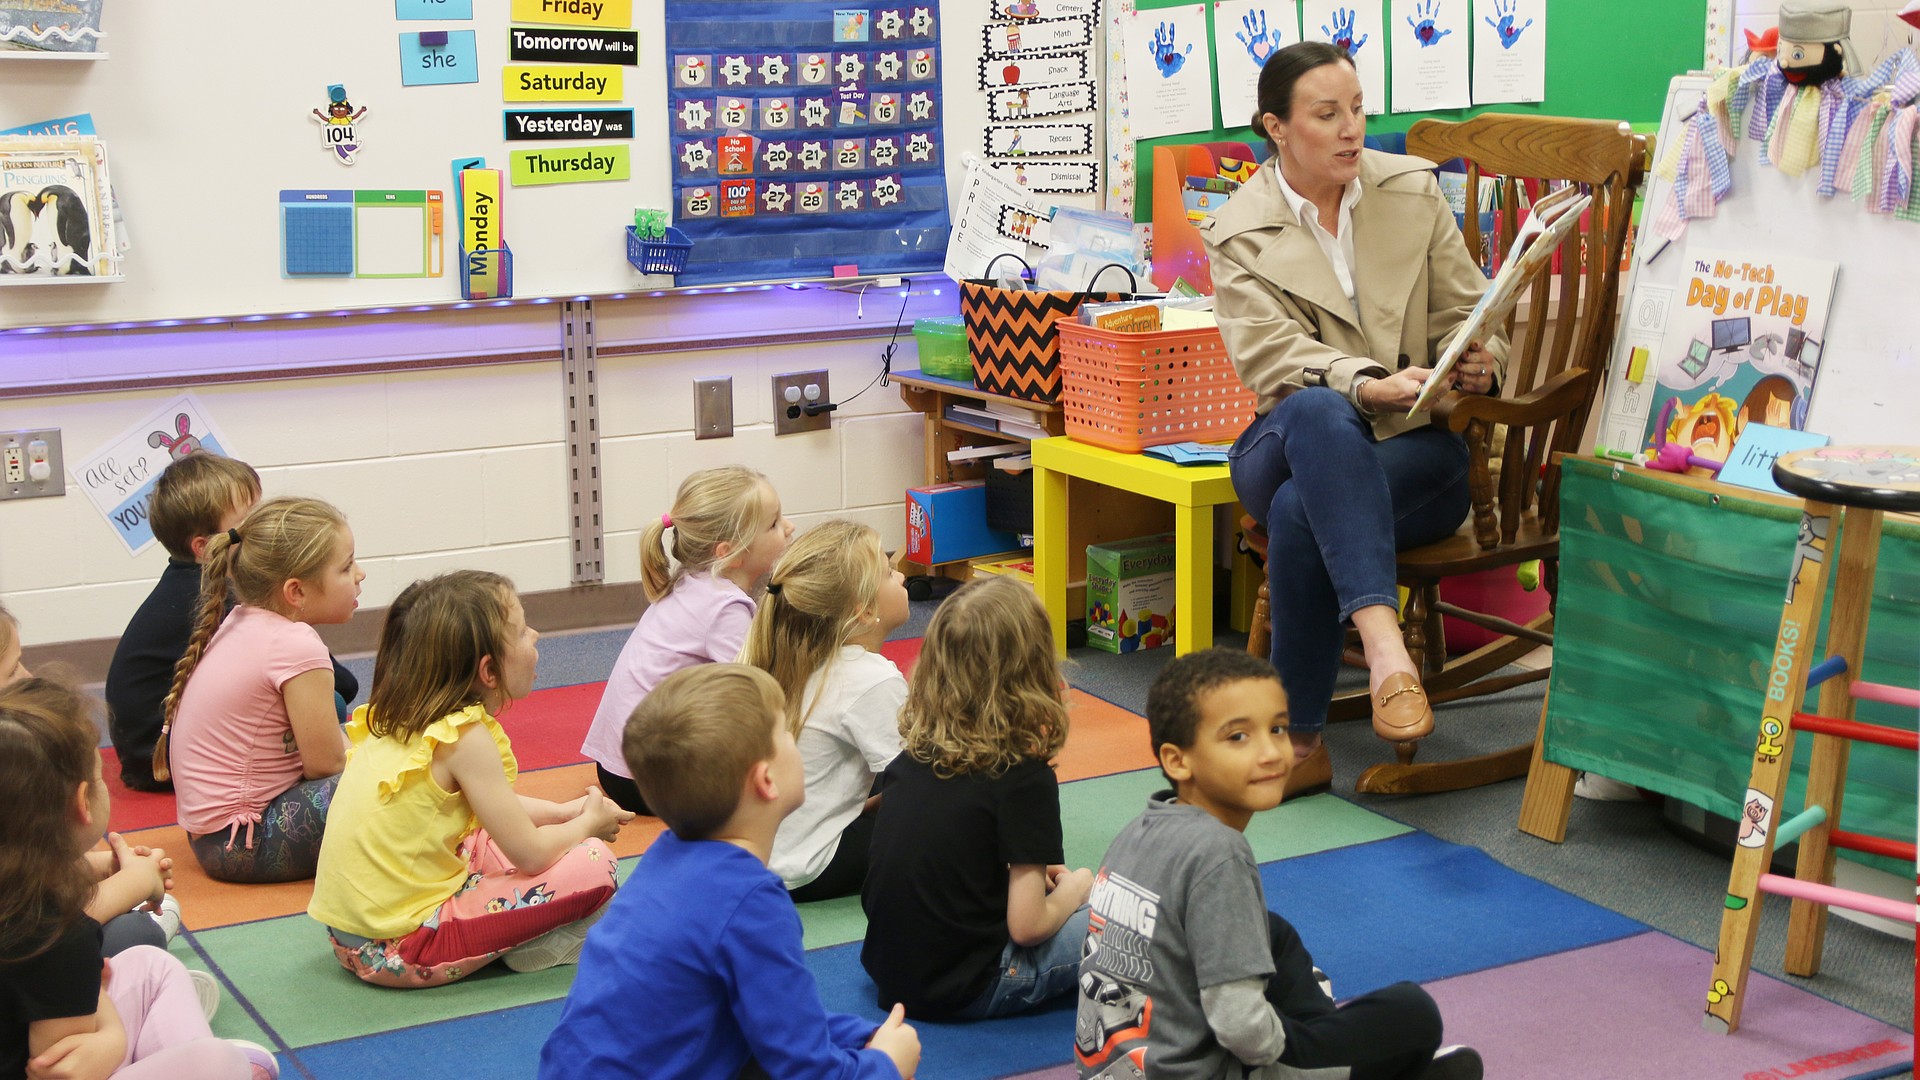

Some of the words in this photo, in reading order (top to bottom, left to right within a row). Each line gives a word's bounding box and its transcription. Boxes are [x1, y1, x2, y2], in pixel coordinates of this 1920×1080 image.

[542, 0, 604, 20] Friday
[1056, 3, 1083, 13] Centers
[887, 18, 895, 30] 2
[918, 16, 925, 27] 3
[1053, 30, 1072, 39] Math
[513, 31, 604, 51] Tomorrow
[605, 42, 621, 52] will
[622, 42, 634, 52] be
[421, 49, 457, 69] she
[731, 65, 740, 76] 5
[769, 64, 778, 75] 6
[846, 62, 854, 73] 8
[884, 61, 893, 72] 9
[915, 62, 927, 74] 10
[1048, 66, 1069, 75] Snack
[688, 69, 698, 81] 4
[811, 68, 819, 79] 7
[520, 72, 607, 95] Saturday
[853, 92, 865, 100] Day
[1049, 90, 1080, 100] Language
[808, 106, 821, 118] 14
[879, 107, 891, 118] 16
[914, 101, 926, 112] 17
[689, 110, 700, 121] 11
[726, 111, 740, 123] 12
[770, 111, 784, 123] 13
[515, 114, 604, 136] Yesterday
[605, 123, 623, 132] was
[326, 127, 354, 143] 104
[1049, 135, 1072, 143] Recess
[724, 145, 746, 153] School
[876, 146, 892, 158] 23
[912, 141, 928, 153] 24
[689, 149, 704, 162] 18
[769, 150, 786, 162] 20
[805, 149, 819, 161] 21
[840, 152, 857, 163] 22
[525, 152, 616, 175] Thursday
[1051, 172, 1081, 181] Dismissal
[768, 191, 785, 203] 27
[841, 189, 857, 201] 29
[878, 185, 895, 198] 30
[691, 200, 708, 212] 25
[803, 195, 820, 207] 28
[470, 191, 494, 276] Monday
[1694, 260, 1711, 273] The
[1713, 259, 1775, 284] No-Tech
[1686, 277, 1731, 316] Day
[1732, 287, 1754, 310] of
[1755, 285, 1809, 326] Play
[1741, 444, 1790, 471] litt
[114, 500, 147, 531] YOU
[1123, 554, 1174, 572] Everyday
[1768, 619, 1801, 702] BOOKS!
